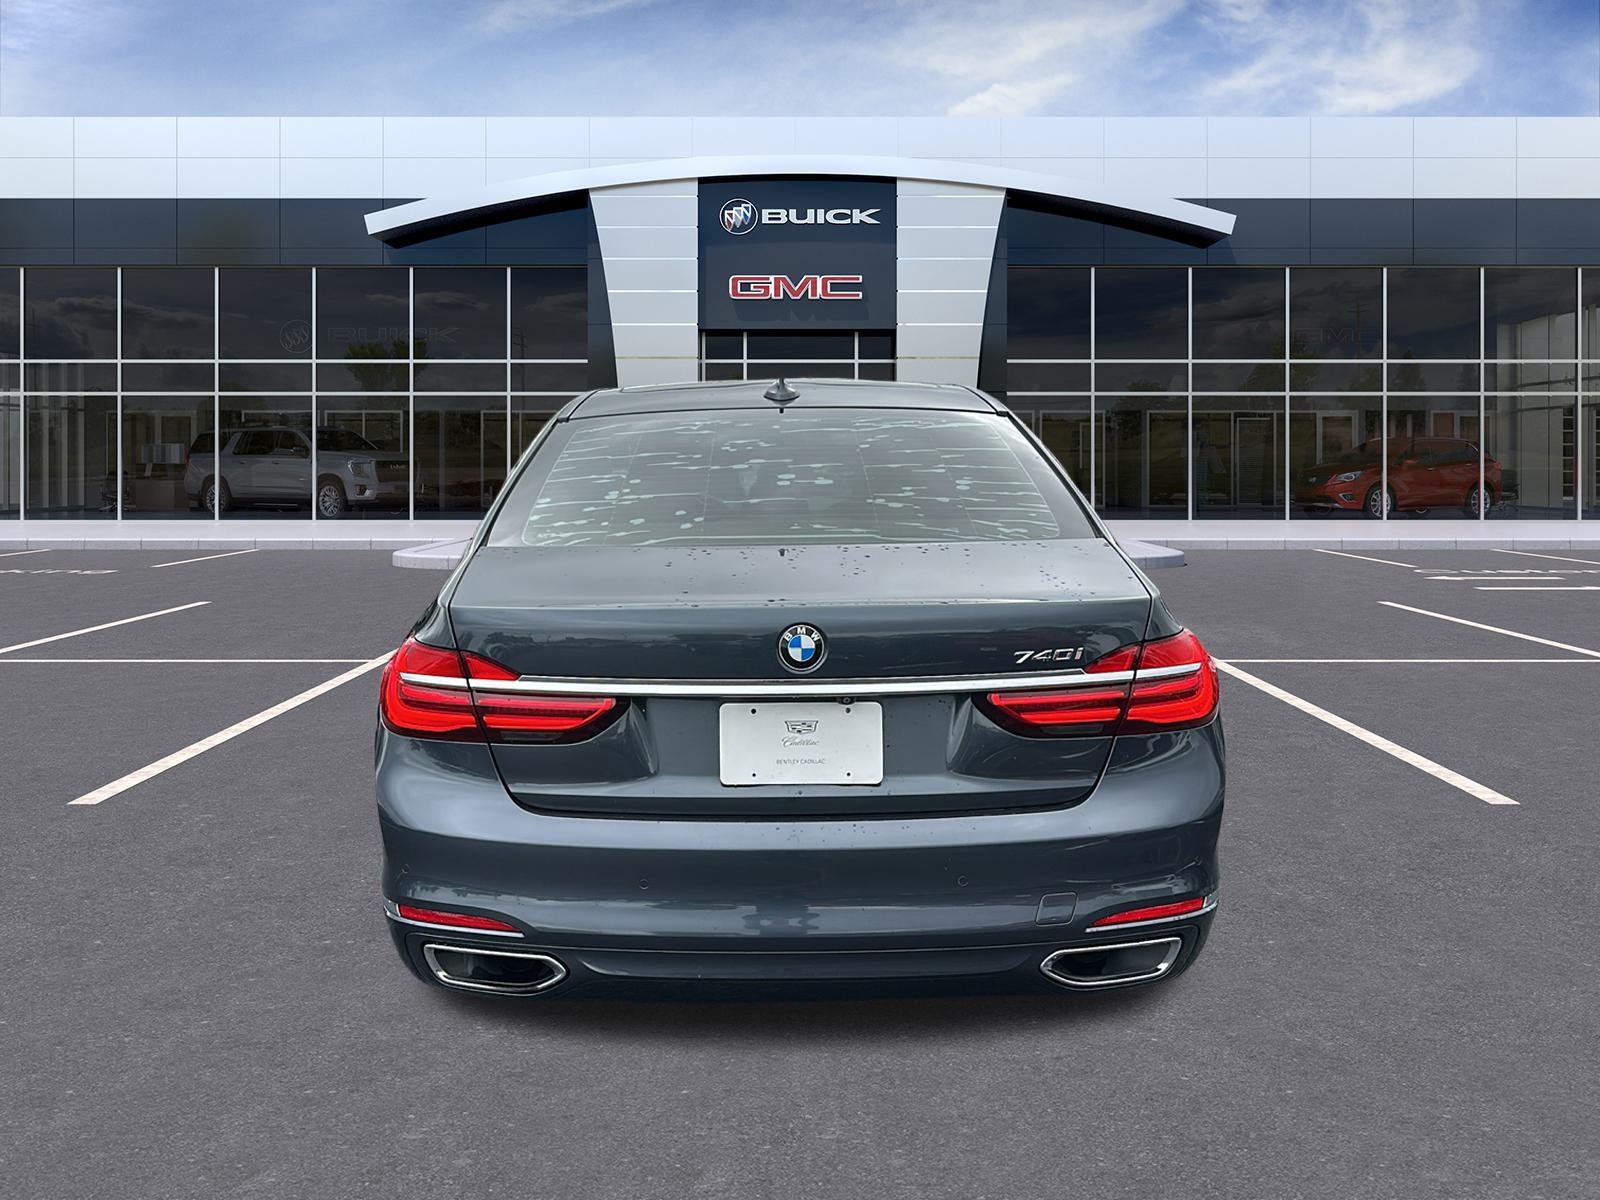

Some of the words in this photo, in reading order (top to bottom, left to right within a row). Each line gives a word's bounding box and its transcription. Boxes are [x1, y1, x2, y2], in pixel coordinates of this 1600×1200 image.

[761, 208, 881, 224] BUICK
[729, 275, 863, 300] GMC
[327, 327, 460, 344] BUICK
[783, 626, 821, 642] BMW
[1013, 647, 1084, 664] 740i
[781, 736, 819, 748] Cadillac
